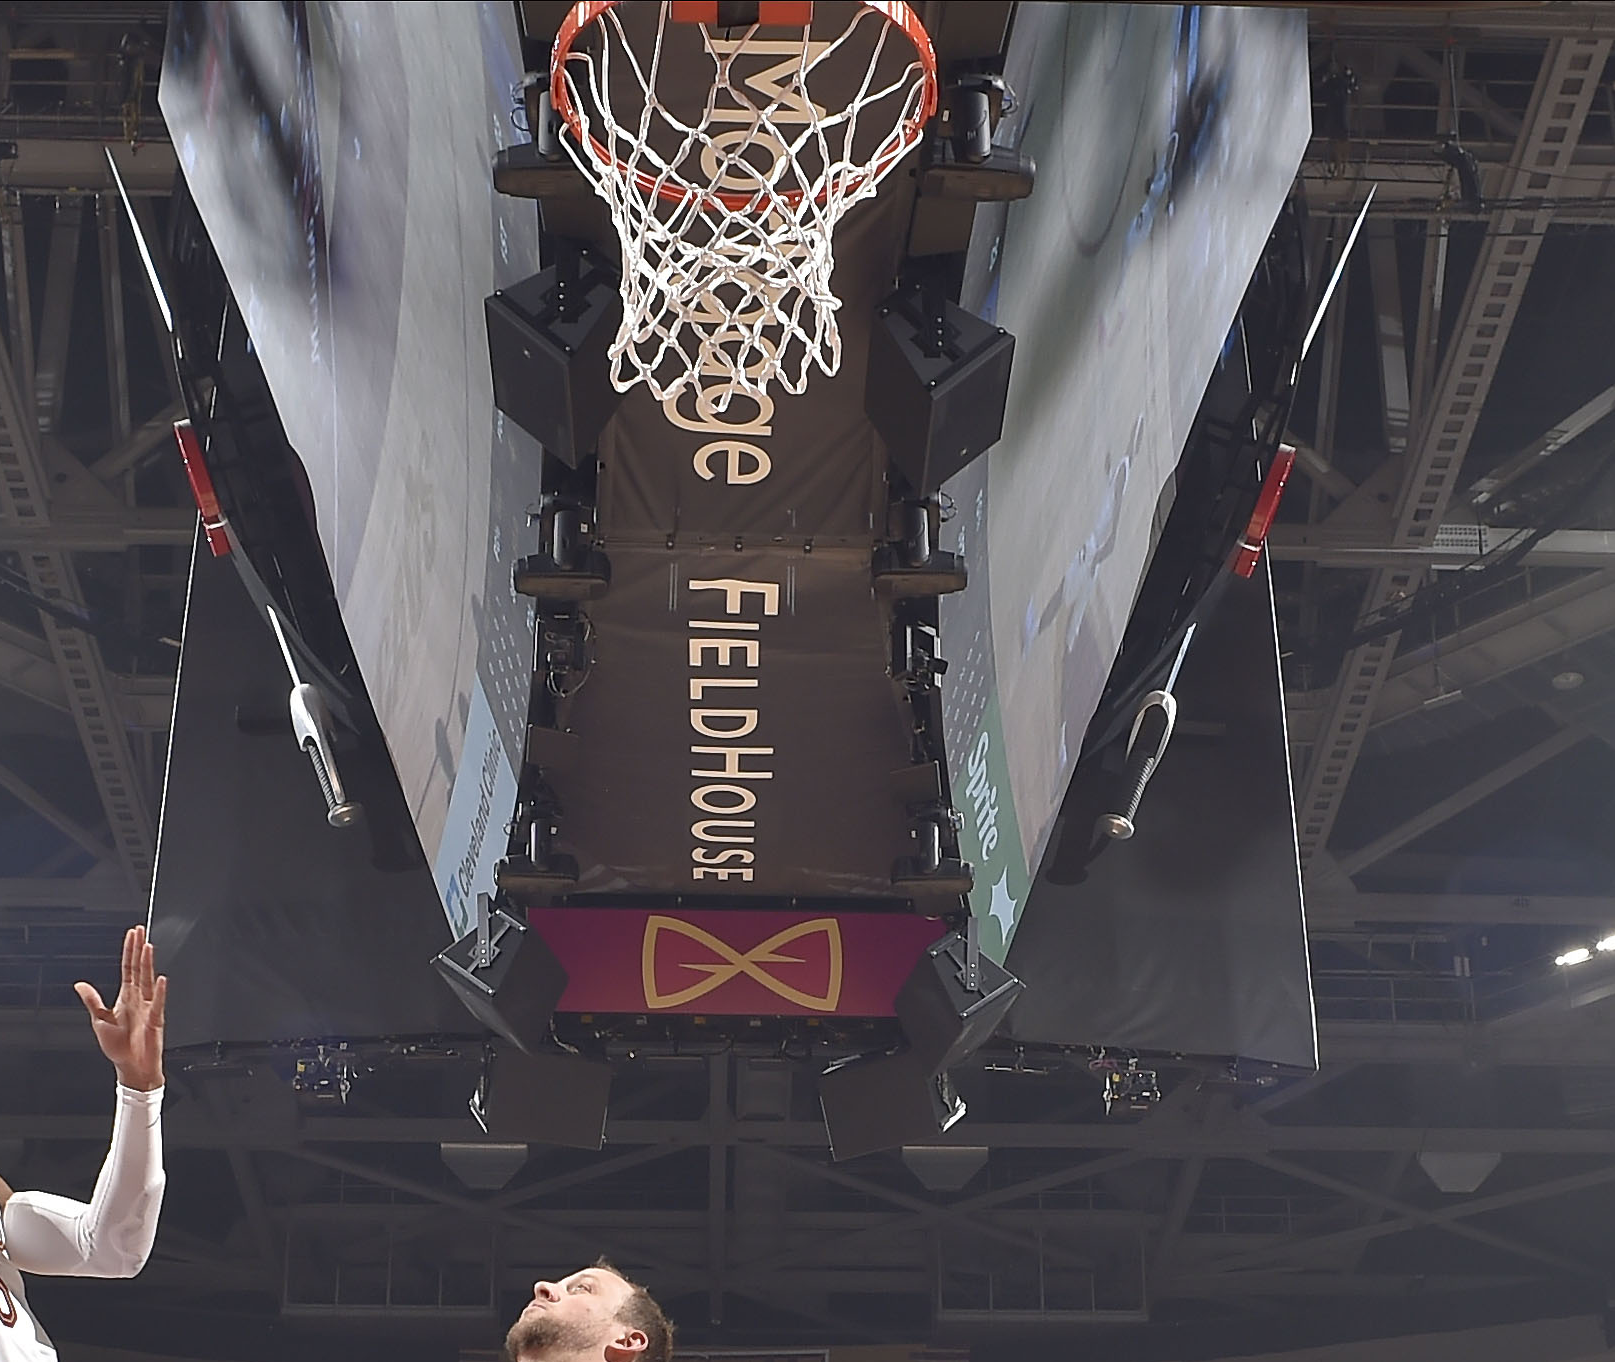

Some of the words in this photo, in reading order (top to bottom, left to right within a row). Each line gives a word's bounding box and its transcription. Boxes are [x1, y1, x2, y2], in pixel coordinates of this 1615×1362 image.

[688, 577, 778, 883] FIELDHOUSE
[458, 784, 492, 899] Cleveland
[966, 731, 999, 861] Sprite
